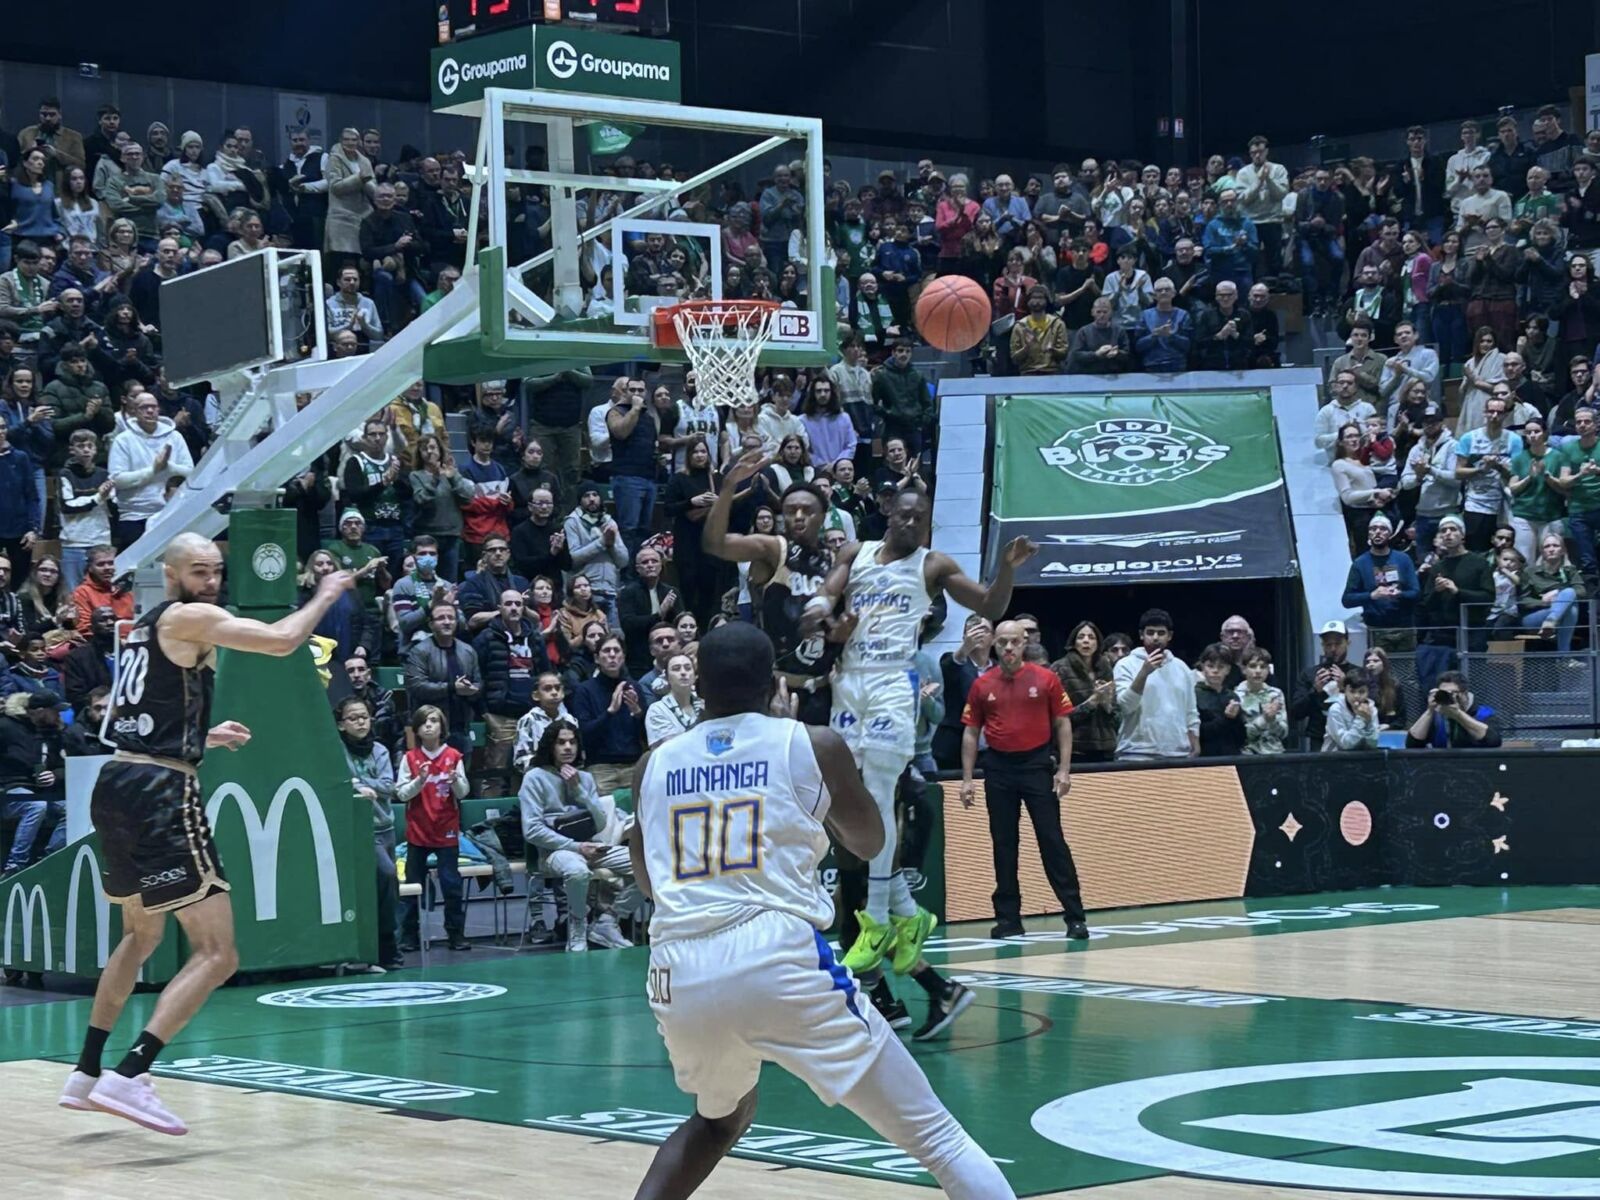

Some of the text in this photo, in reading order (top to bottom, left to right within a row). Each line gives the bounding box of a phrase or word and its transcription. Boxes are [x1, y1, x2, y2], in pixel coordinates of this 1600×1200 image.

[461, 54, 527, 82] Groupama
[581, 53, 670, 81] Groupama
[1105, 422, 1163, 433] ADA
[1039, 443, 1231, 466] BLOIS
[1041, 554, 1243, 574] Agglopolys
[116, 646, 150, 706] 20
[666, 760, 769, 797] MUNANGA
[669, 796, 765, 884] 00
[150, 1057, 476, 1101] SIDAMO
